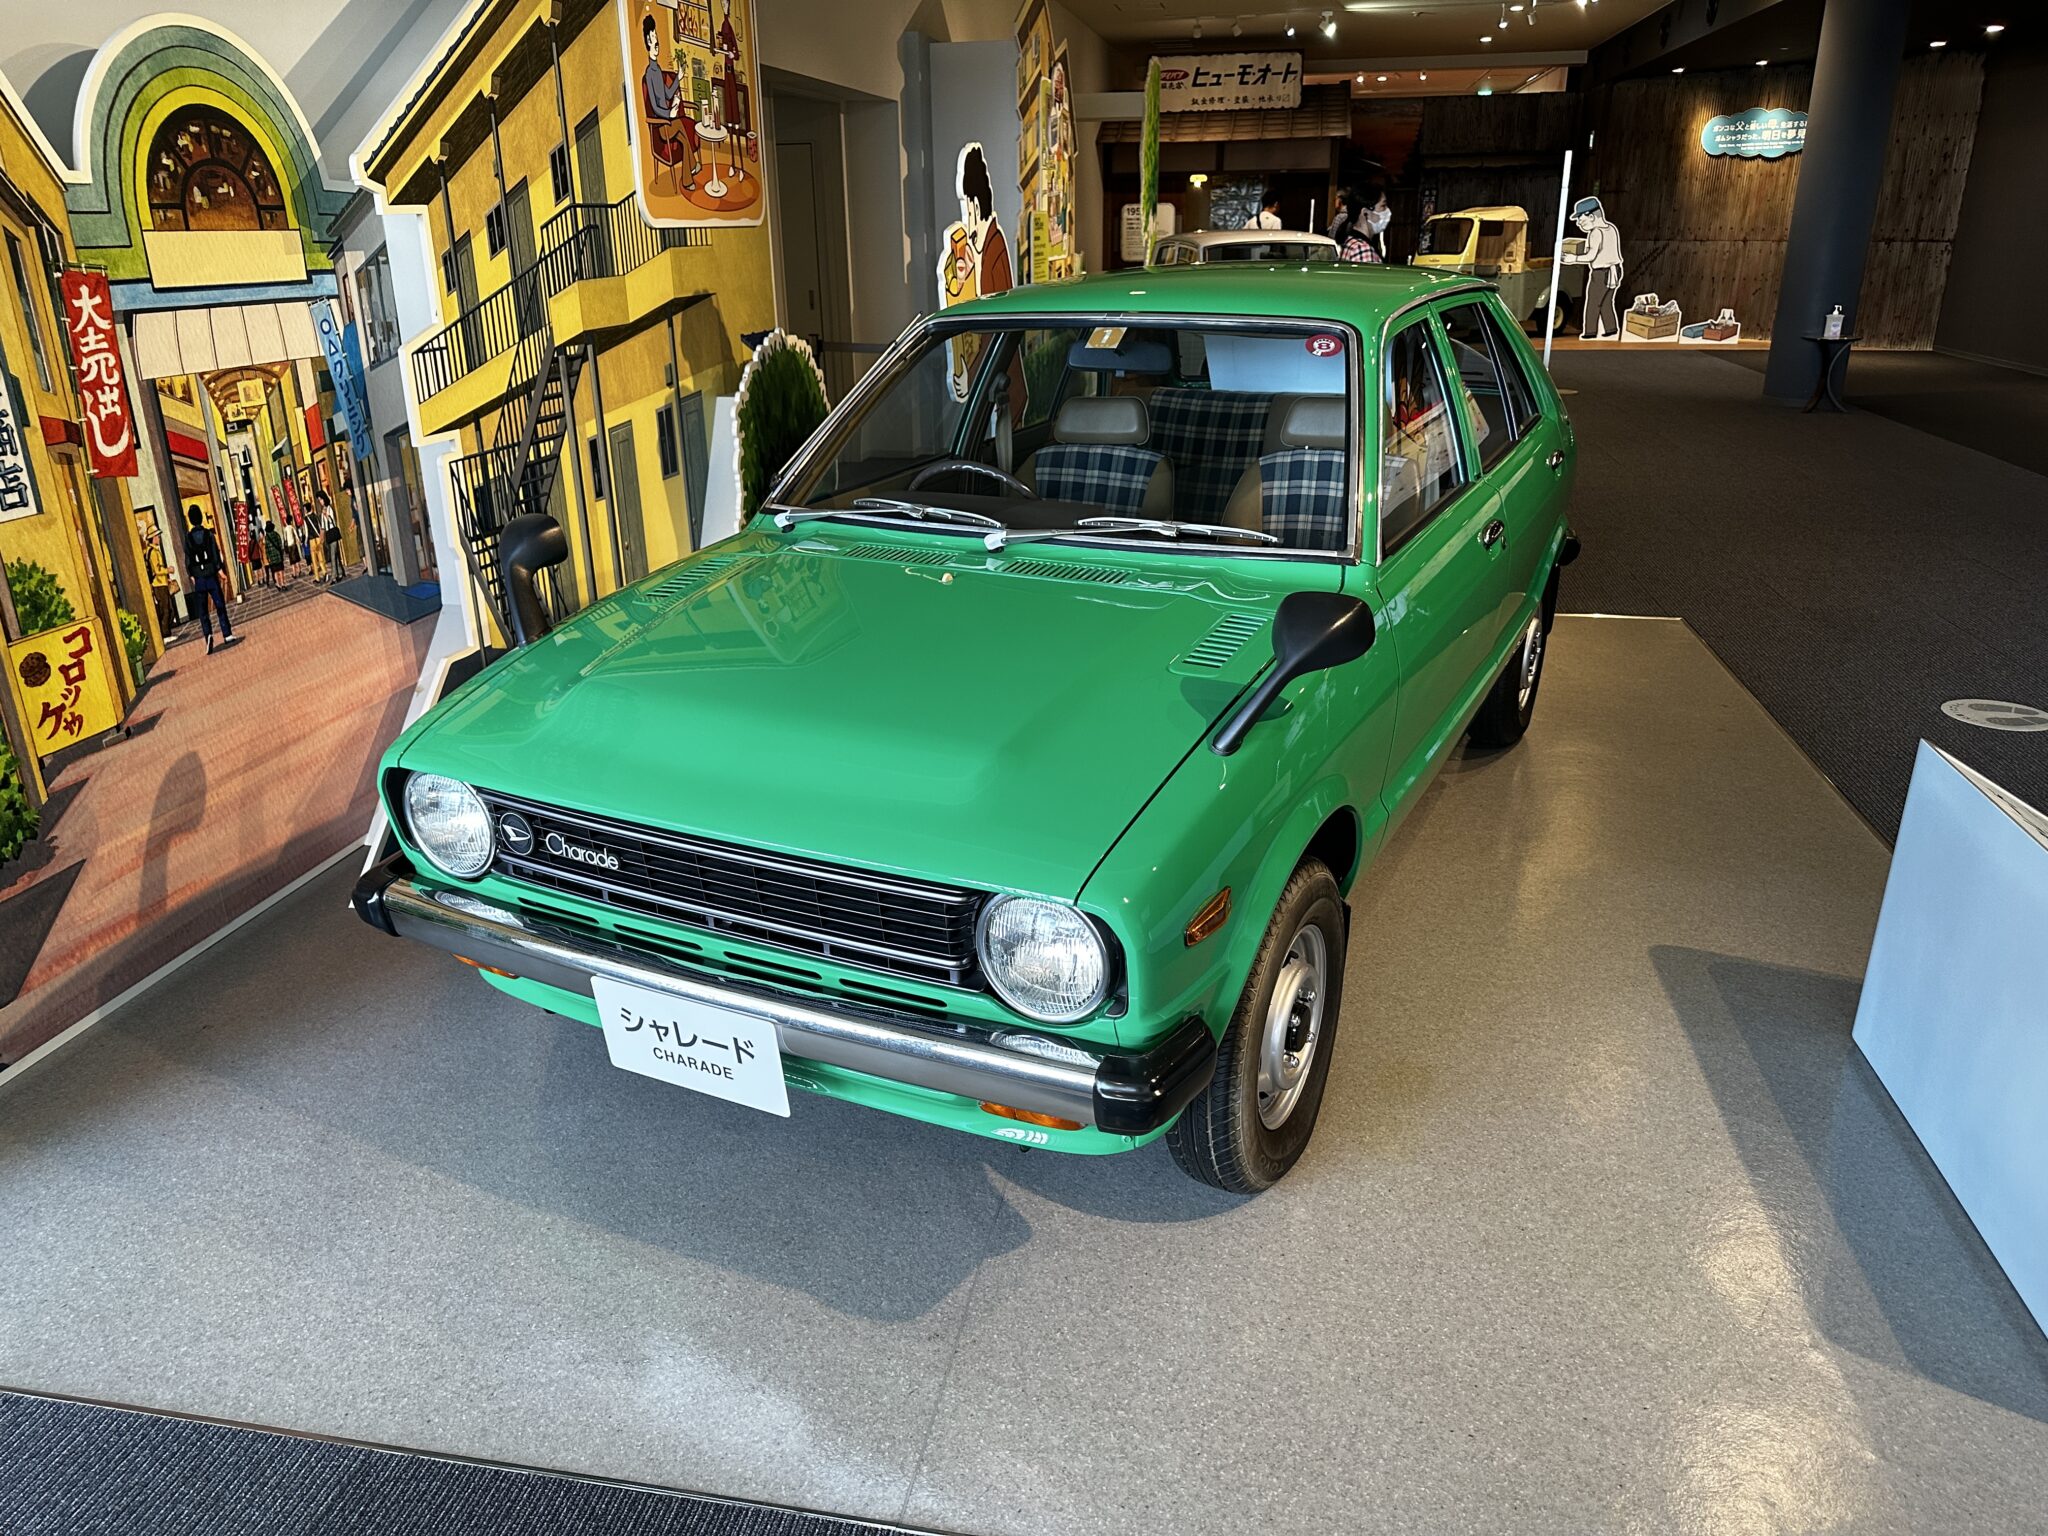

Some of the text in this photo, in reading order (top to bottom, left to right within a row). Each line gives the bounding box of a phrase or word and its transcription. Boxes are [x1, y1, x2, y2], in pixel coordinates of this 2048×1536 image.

[1126, 207, 1140, 216] 195
[72, 284, 130, 458] 大売出し
[545, 832, 619, 870] Charade
[620, 1007, 755, 1065] シャレード
[653, 1047, 735, 1080] CHARADE
